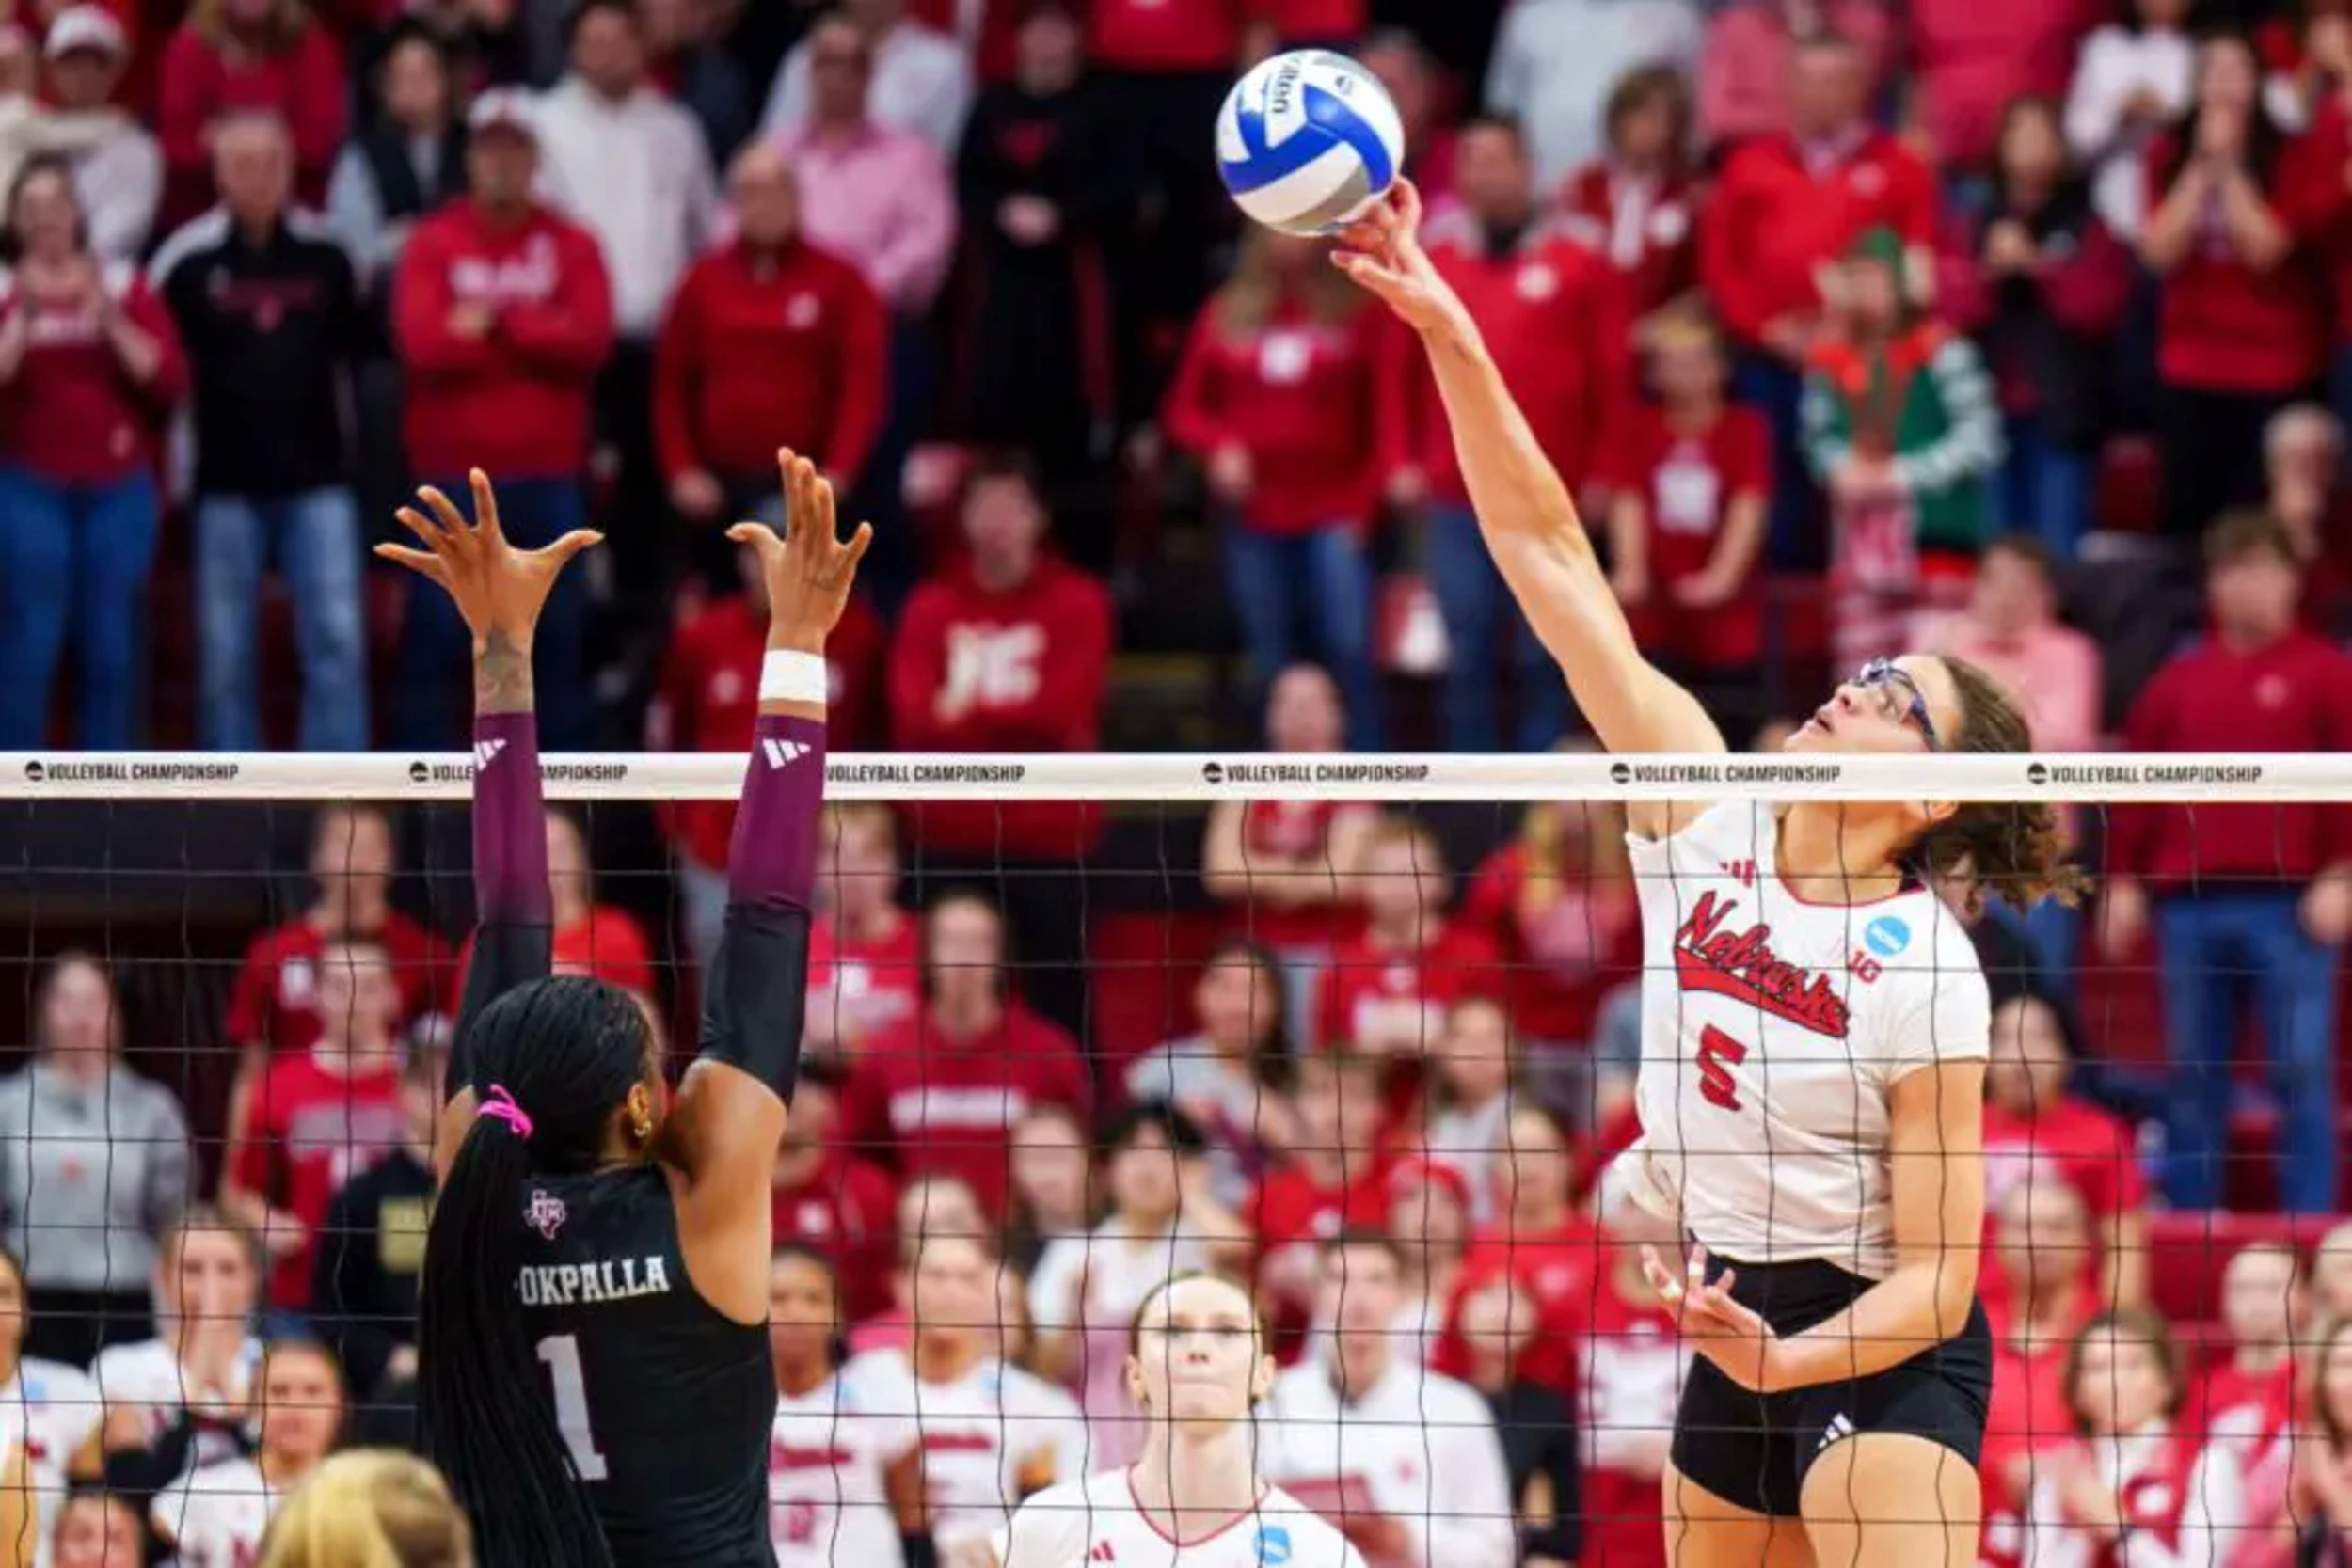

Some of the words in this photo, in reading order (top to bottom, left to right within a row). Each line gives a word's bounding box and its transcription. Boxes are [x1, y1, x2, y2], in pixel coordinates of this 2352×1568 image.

[47, 763, 128, 781] VOLLEYBALL
[132, 763, 239, 781] CHAMPIONSHIP
[432, 764, 474, 782] VOLLE
[539, 764, 628, 782] MPIONSHIP
[825, 765, 910, 782] VOLLEYBALL
[914, 765, 1025, 782] CHAMPIONSHIP
[1227, 764, 1312, 783] VOLLEYBALL
[1316, 764, 1429, 783] CHAMPIONSHIP
[1635, 765, 1722, 783] VOLLEYBALL
[1725, 765, 1841, 783] CHAMPIONSHIP
[2051, 766, 2140, 783] VOLLEYBALL
[2144, 766, 2263, 783] CHAMPIONSHIP
[1674, 889, 1851, 1038] Nebraska
[1696, 1022, 1747, 1112] 5
[535, 1333, 608, 1481] 1
